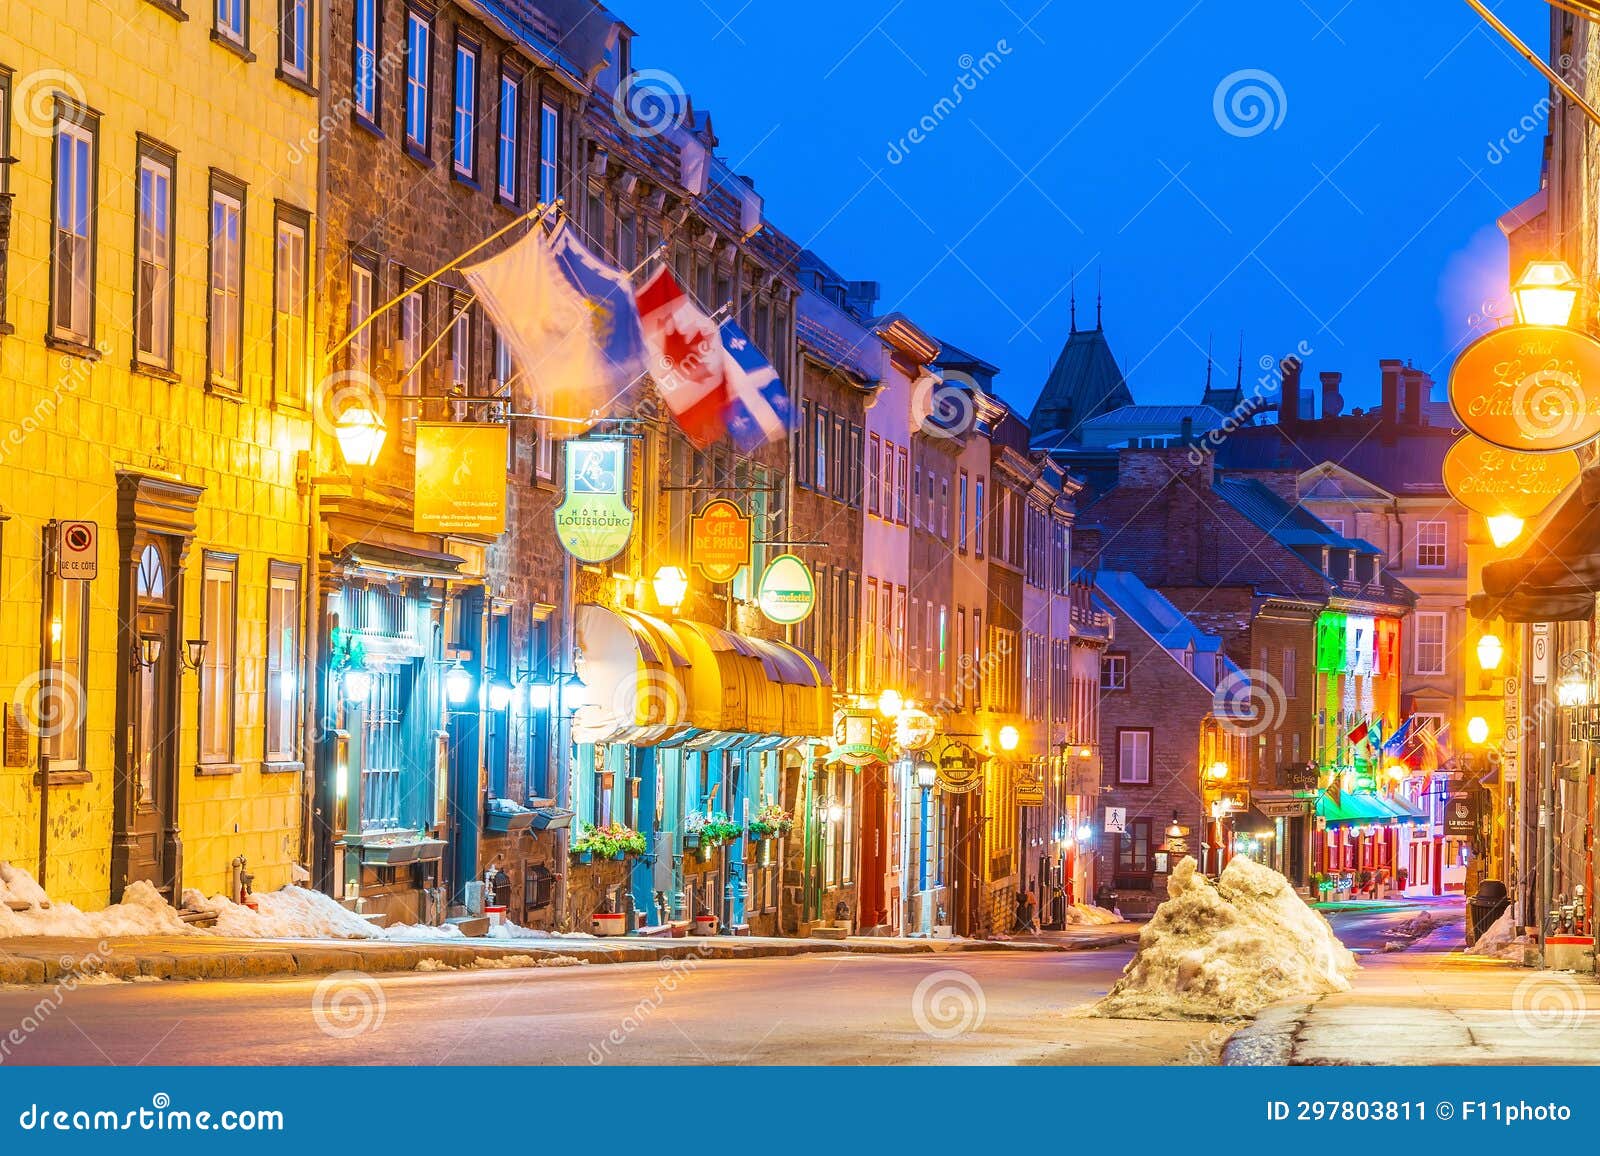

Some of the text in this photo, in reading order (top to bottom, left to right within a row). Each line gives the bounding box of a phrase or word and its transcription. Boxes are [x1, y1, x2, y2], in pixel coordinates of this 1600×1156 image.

[1494, 359, 1526, 387] Le
[1480, 450, 1504, 471] Le
[572, 509, 617, 517] HÔTEL
[696, 536, 745, 550] DE PARIS
